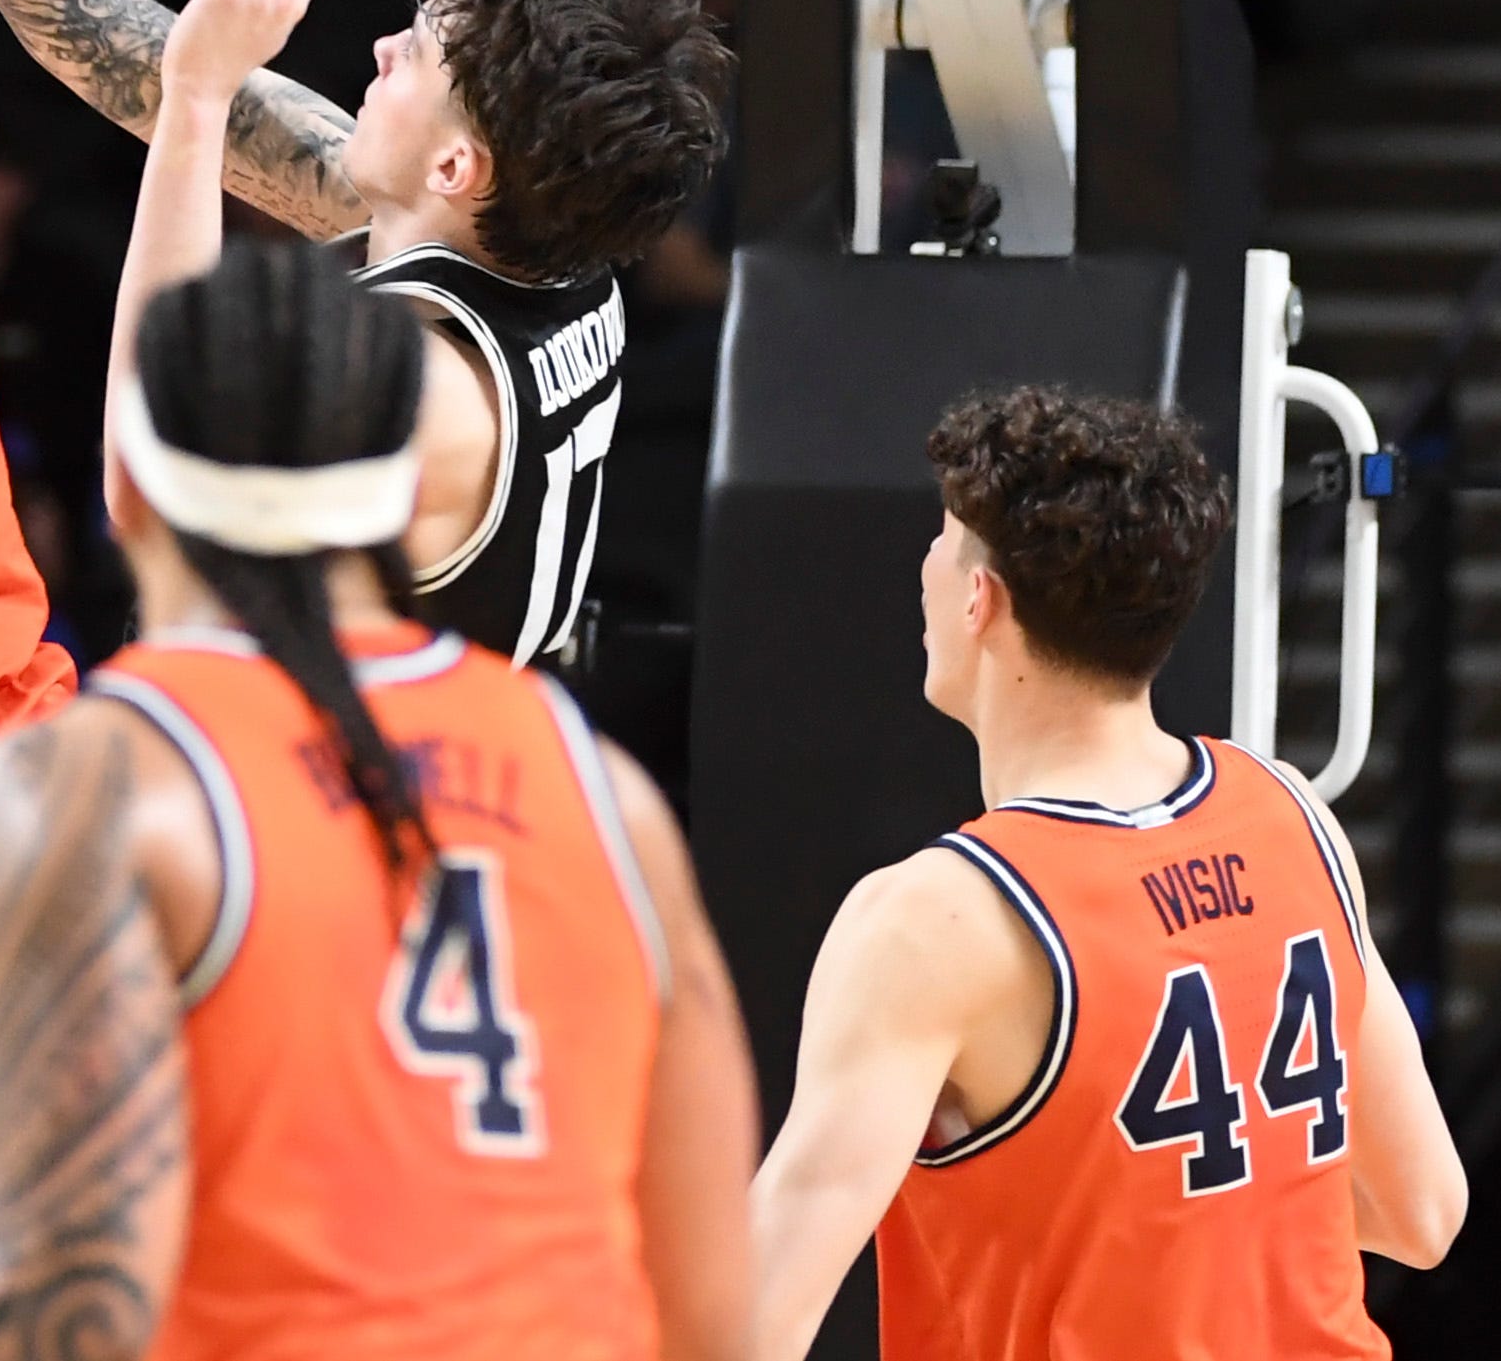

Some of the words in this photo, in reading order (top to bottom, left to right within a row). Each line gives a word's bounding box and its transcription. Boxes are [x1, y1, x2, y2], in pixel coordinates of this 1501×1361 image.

[510, 377, 622, 672] 17
[378, 847, 549, 1159] 4
[1141, 853, 1255, 937] IVISIC
[1112, 928, 1349, 1199] 44
